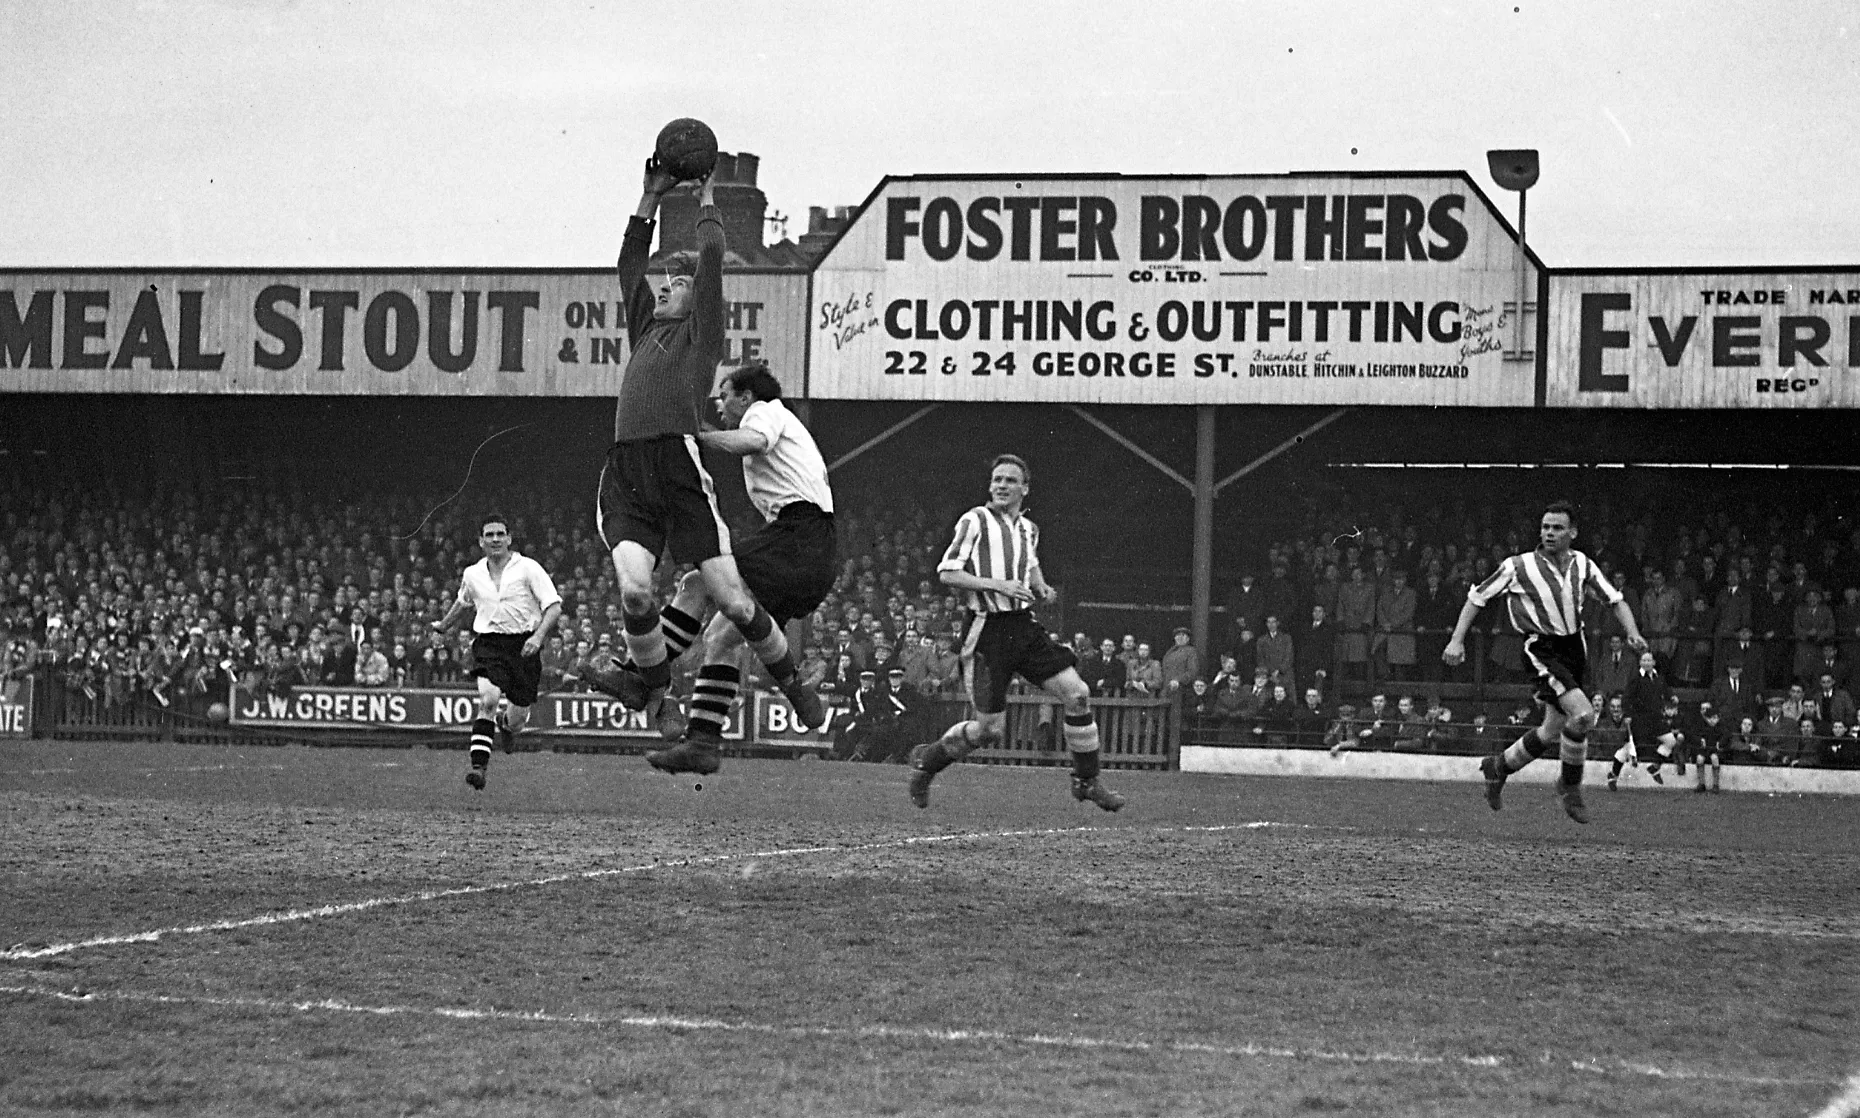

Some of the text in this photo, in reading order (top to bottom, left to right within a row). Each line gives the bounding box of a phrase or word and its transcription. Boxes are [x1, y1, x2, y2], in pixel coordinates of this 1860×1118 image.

[886, 193, 1469, 262] FOSTER BROTHERS
[1128, 270, 1207, 283] CO. LTD.
[819, 292, 860, 329] Style
[1700, 289, 1786, 305] TRADE
[0, 283, 541, 374] MEAL STOUT
[565, 301, 606, 330] ON
[884, 299, 1462, 343] CLOTHING & OUTFITTING
[557, 337, 623, 365] & IN
[1253, 348, 1332, 362] Branches at
[1578, 292, 1860, 393] EVER
[884, 350, 1239, 379] 22 & 24 GEORGE ST.
[1314, 363, 1356, 378] HITCHIN
[1367, 362, 1416, 378] LEIGHTON
[1418, 363, 1469, 379] BUZZARD
[555, 700, 648, 729] LUTON
